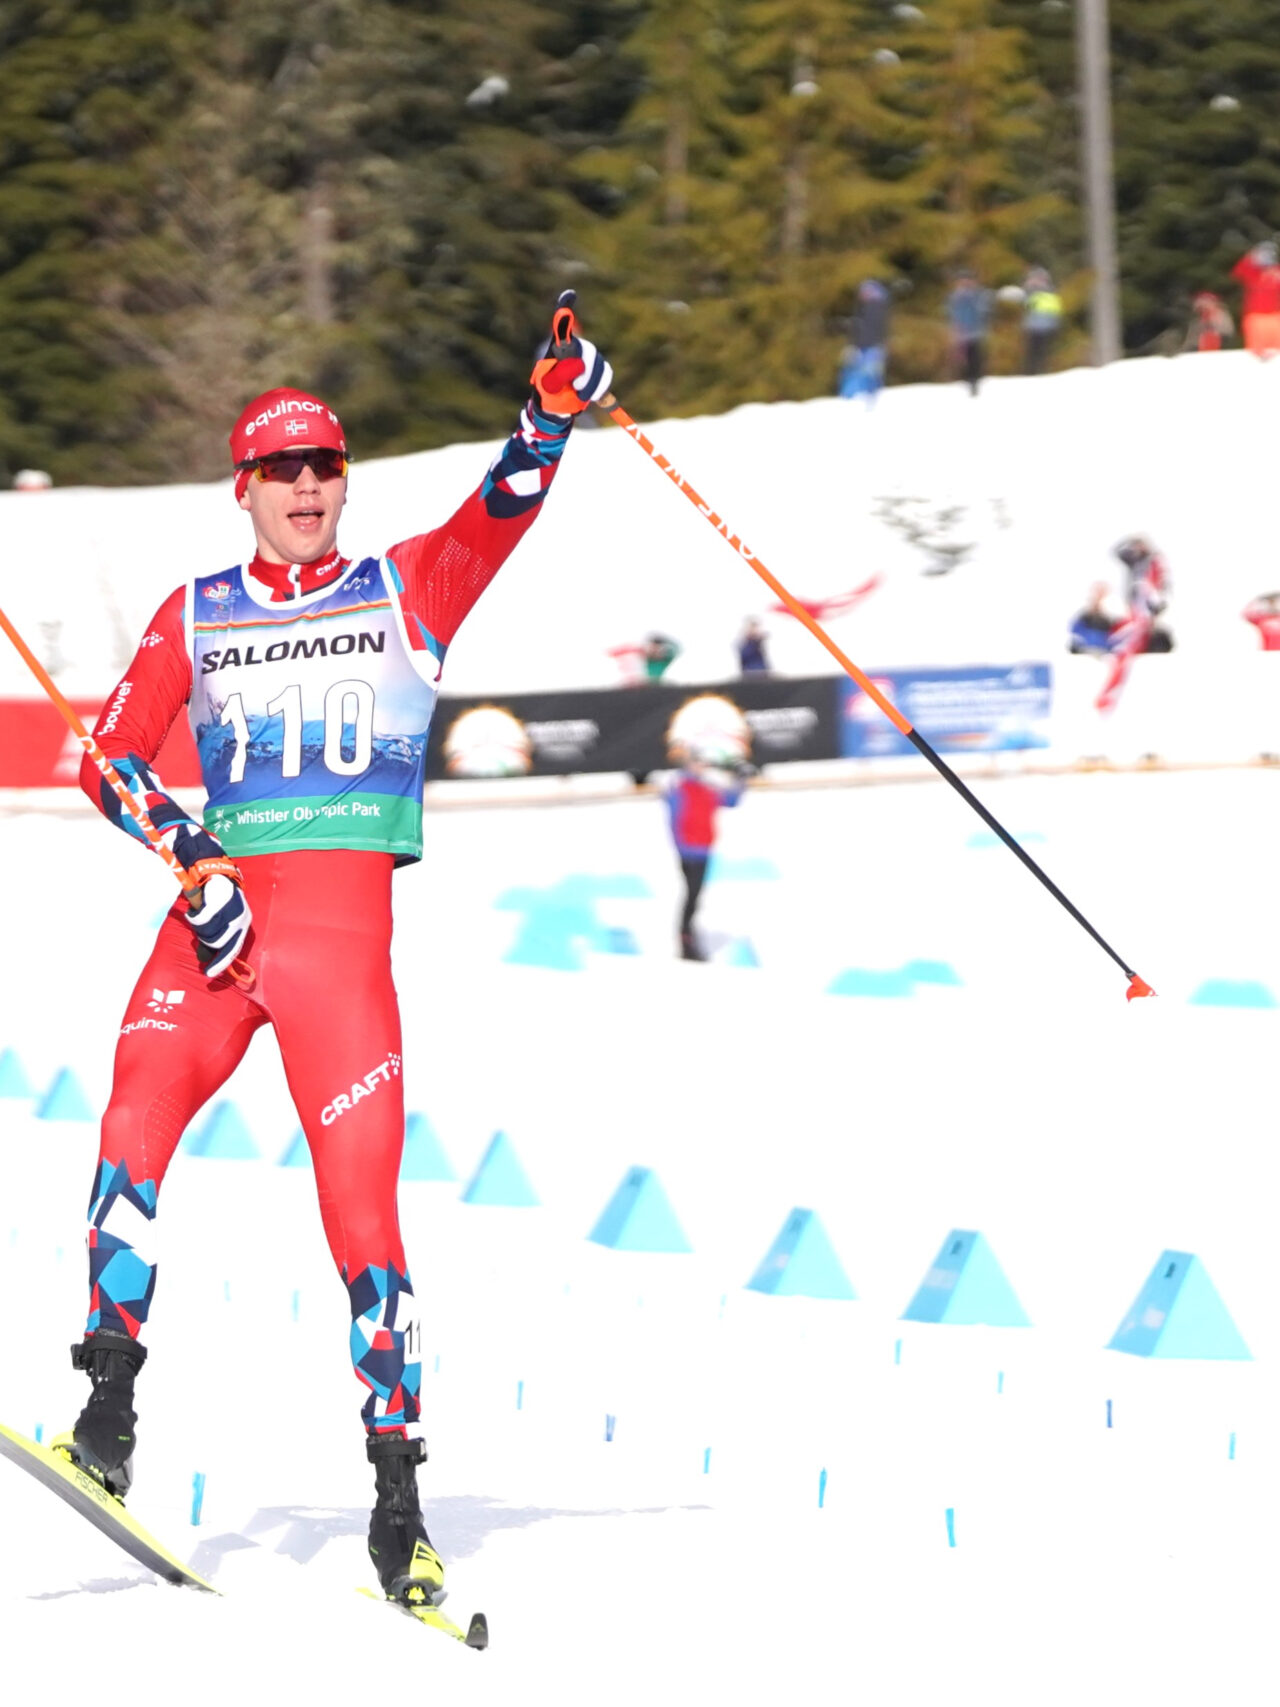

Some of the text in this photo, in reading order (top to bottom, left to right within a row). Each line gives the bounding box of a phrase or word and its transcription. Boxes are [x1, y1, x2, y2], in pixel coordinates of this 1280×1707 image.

[245, 400, 324, 436] equinor
[201, 631, 386, 675] SALOMON
[97, 680, 133, 736] bouvet
[220, 679, 376, 784] 110
[236, 809, 290, 825] Whistler
[352, 802, 381, 817] Park
[120, 1017, 178, 1035] quinor
[321, 1061, 390, 1126] CRAFT
[74, 1471, 109, 1504] FISCHER
